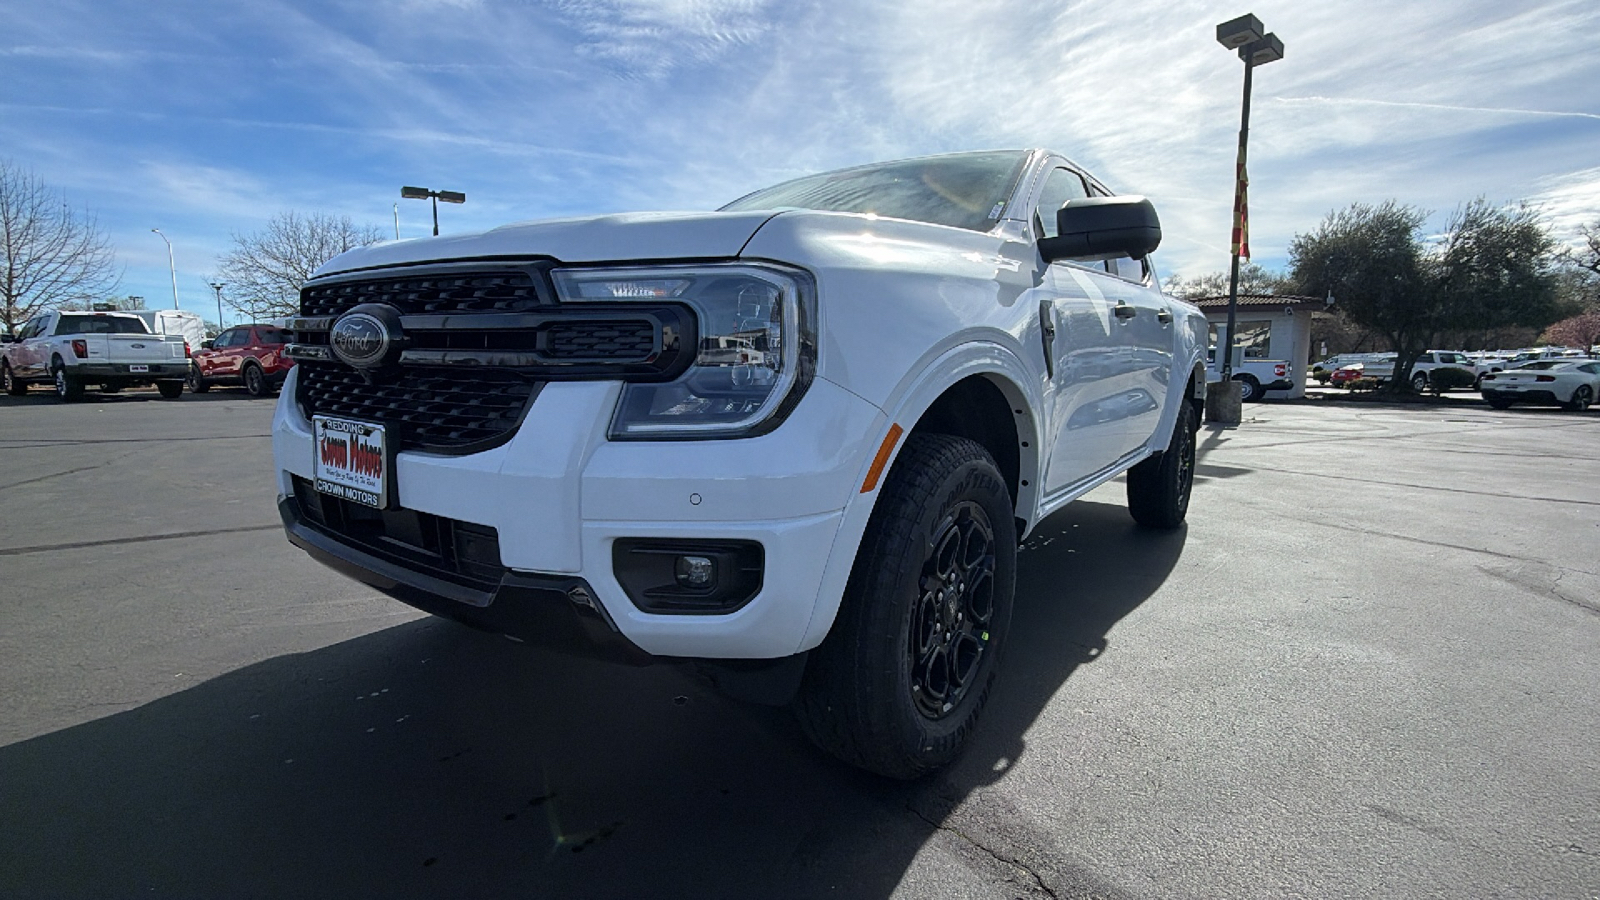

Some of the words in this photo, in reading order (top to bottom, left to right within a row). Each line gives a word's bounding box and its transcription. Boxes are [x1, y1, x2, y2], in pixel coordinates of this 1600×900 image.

[338, 323, 371, 351] Ford
[326, 420, 364, 434] REDDING
[317, 481, 344, 496] CROWN
[345, 488, 378, 506] MOTORS
